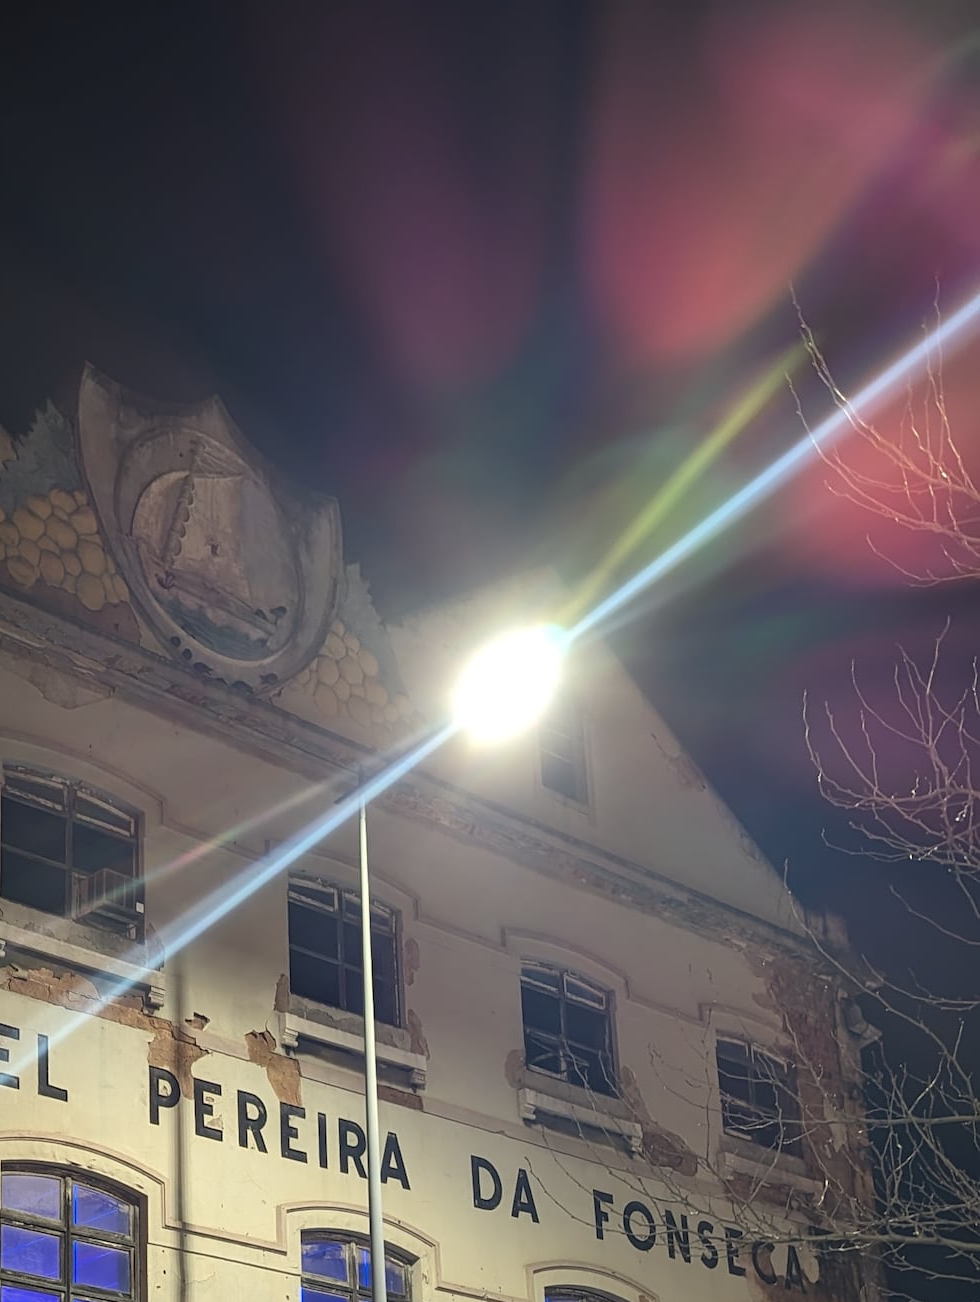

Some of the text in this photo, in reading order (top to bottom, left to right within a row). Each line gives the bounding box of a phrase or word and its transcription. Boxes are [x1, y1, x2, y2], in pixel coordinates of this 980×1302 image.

[149, 1067, 411, 1191] PEREIRA
[471, 1155, 540, 1223] DA
[593, 1190, 807, 1295] FONSECA
